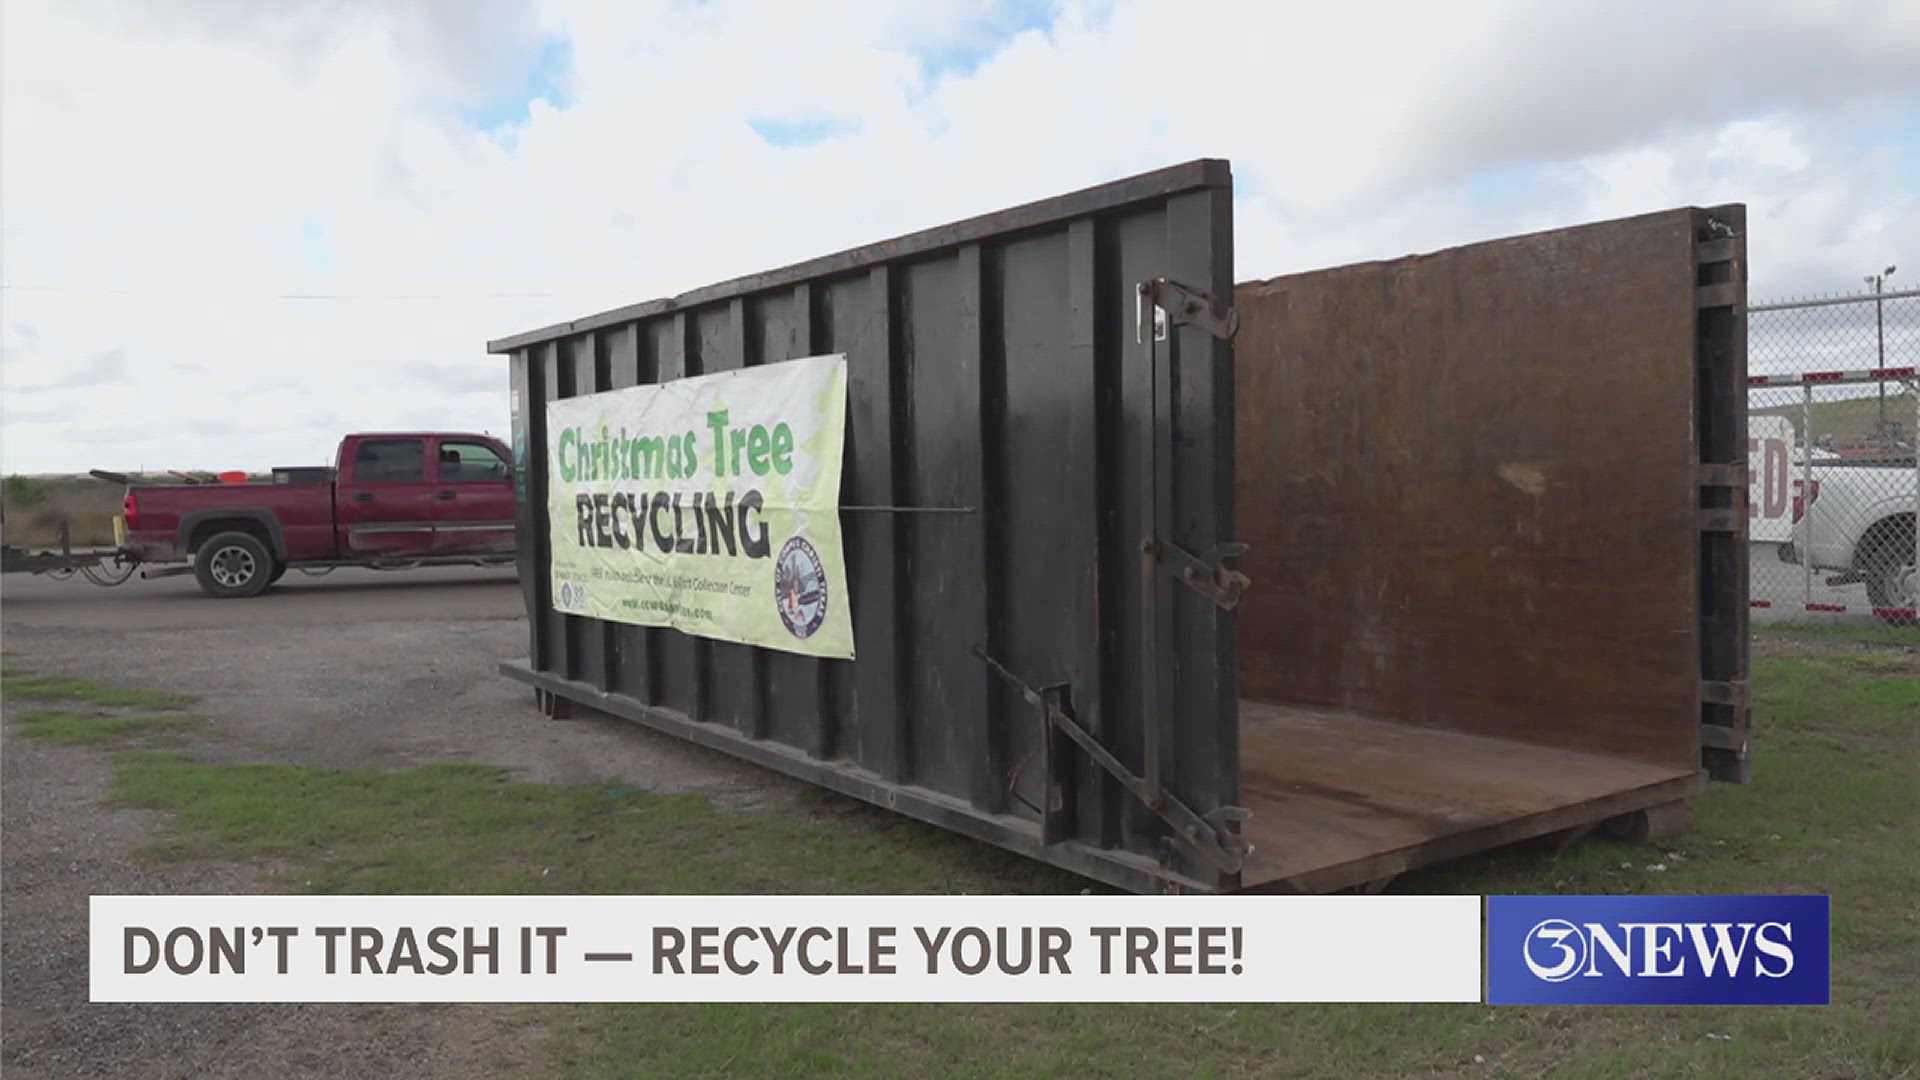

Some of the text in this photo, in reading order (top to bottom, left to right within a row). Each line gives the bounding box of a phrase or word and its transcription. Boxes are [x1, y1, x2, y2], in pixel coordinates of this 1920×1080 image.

[559, 427, 697, 483] Christmas
[706, 409, 794, 477] Tree
[576, 490, 771, 559] RECYCLING
[693, 578, 727, 595] Collection
[729, 582, 752, 597] Center
